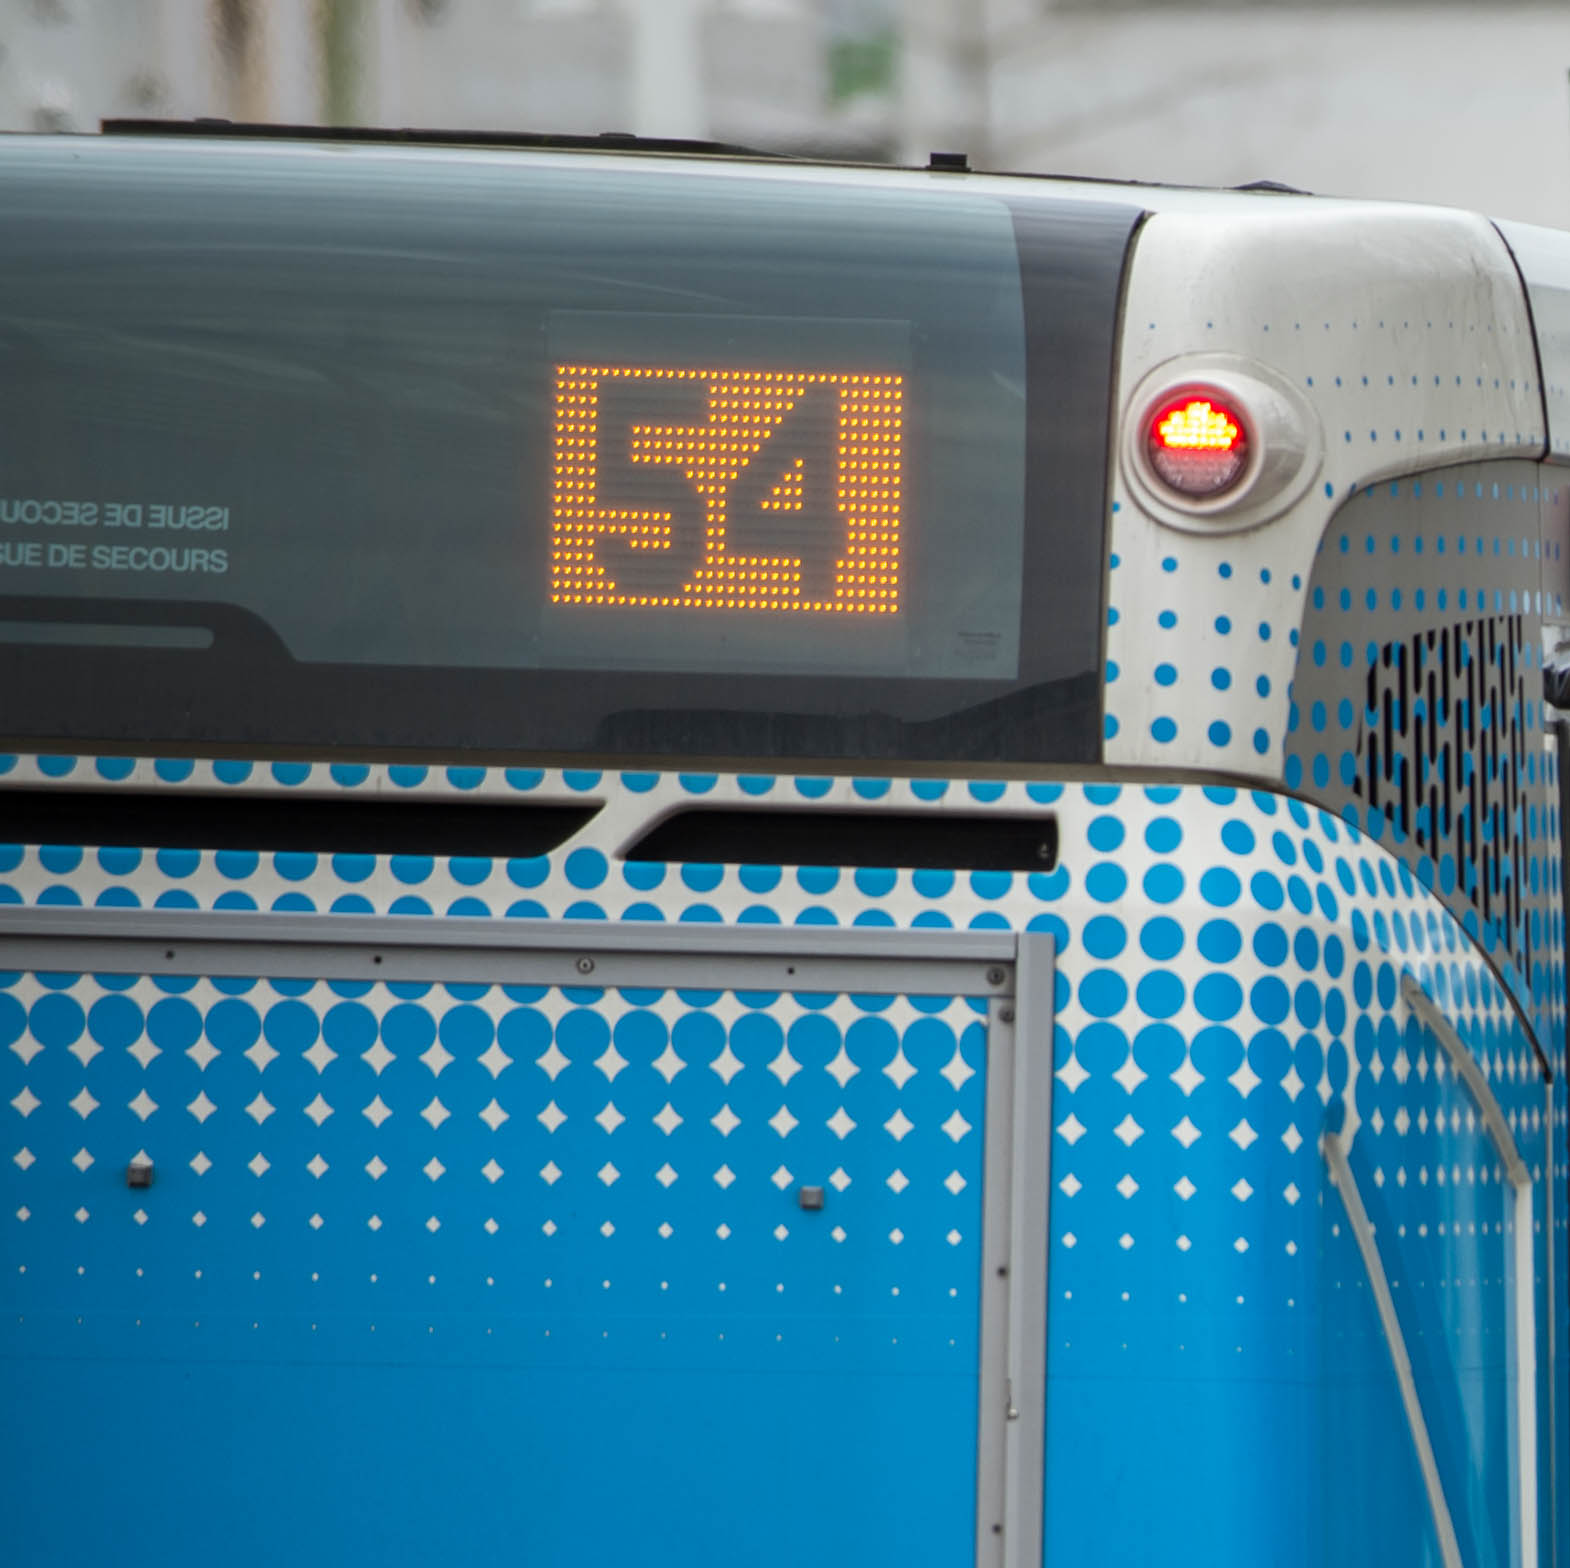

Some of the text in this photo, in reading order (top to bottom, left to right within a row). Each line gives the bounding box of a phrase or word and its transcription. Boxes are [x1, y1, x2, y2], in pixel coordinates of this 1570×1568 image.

[597, 378, 842, 603] 54
[48, 543, 87, 568] DE
[92, 545, 229, 573] SECOURS
